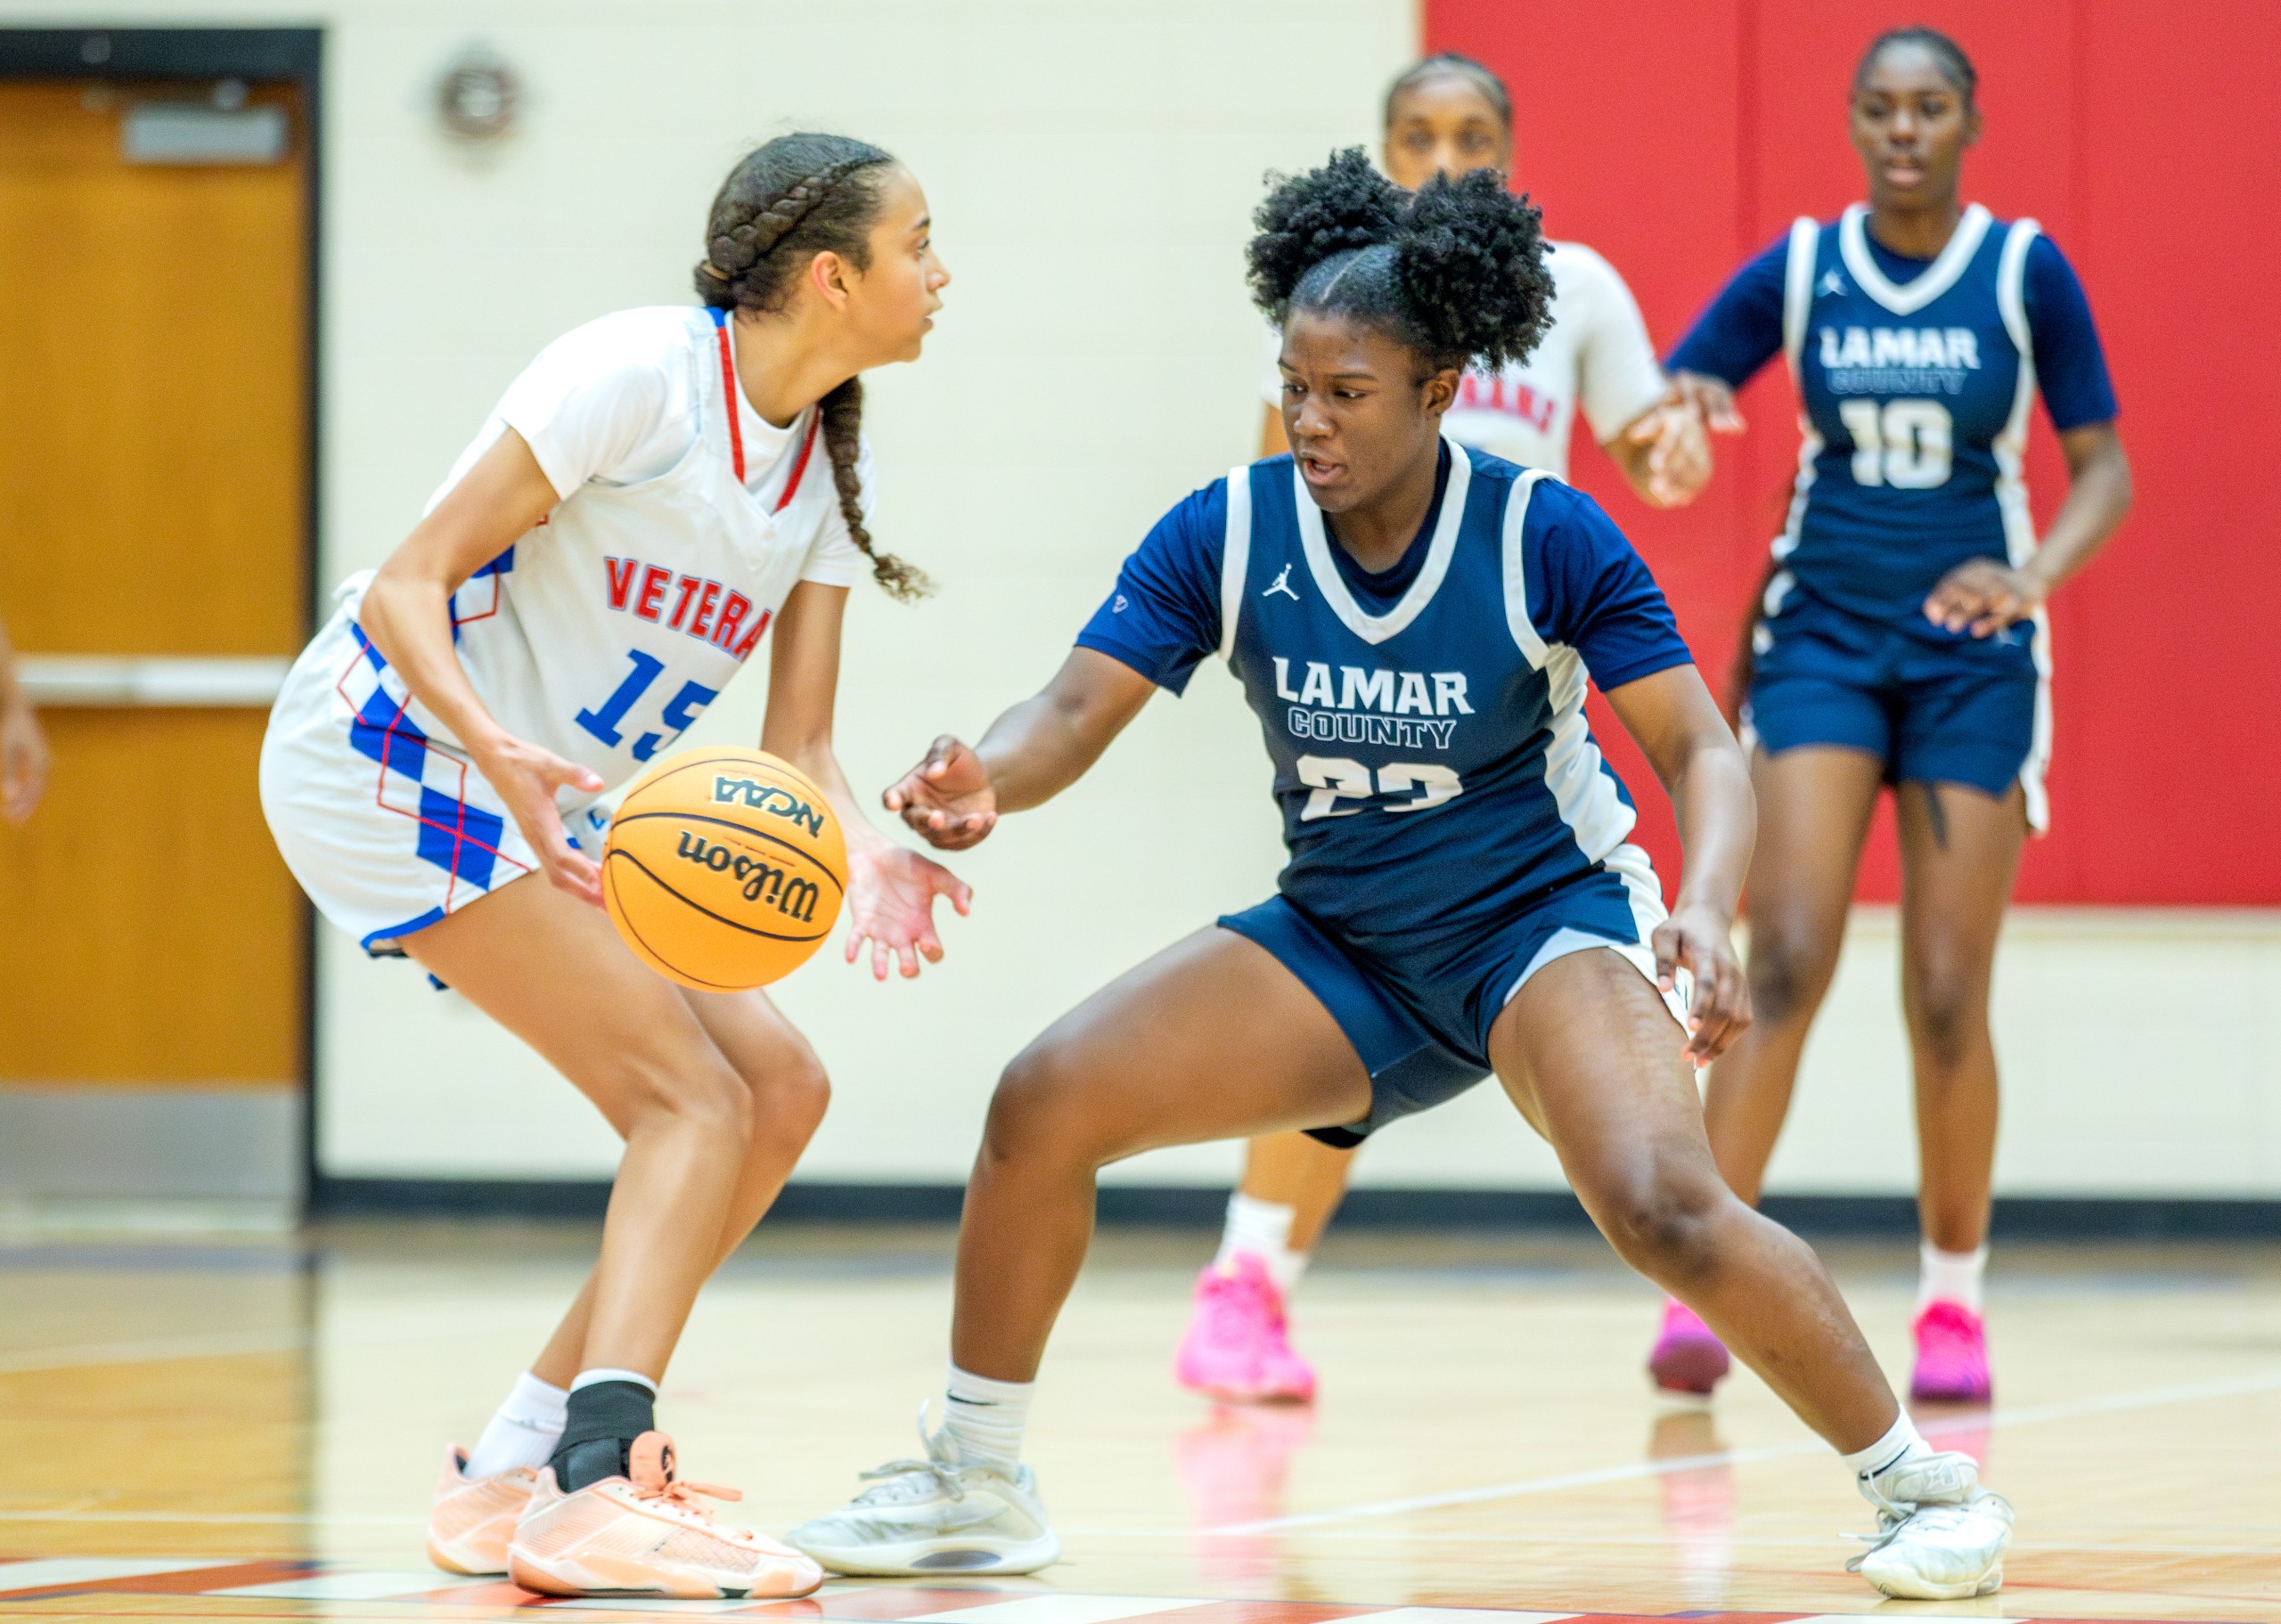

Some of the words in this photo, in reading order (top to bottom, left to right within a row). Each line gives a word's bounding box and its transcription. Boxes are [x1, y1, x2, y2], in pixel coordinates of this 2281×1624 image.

[1819, 326, 1982, 370] LAMAR
[1839, 398, 1953, 489] 10
[574, 649, 720, 763] 15
[1272, 657, 1476, 715] LAMAR
[1288, 706, 1457, 749] COUNTY
[715, 775, 824, 838] NCAA
[1296, 754, 1464, 822] 23
[677, 830, 819, 923] Wilson
